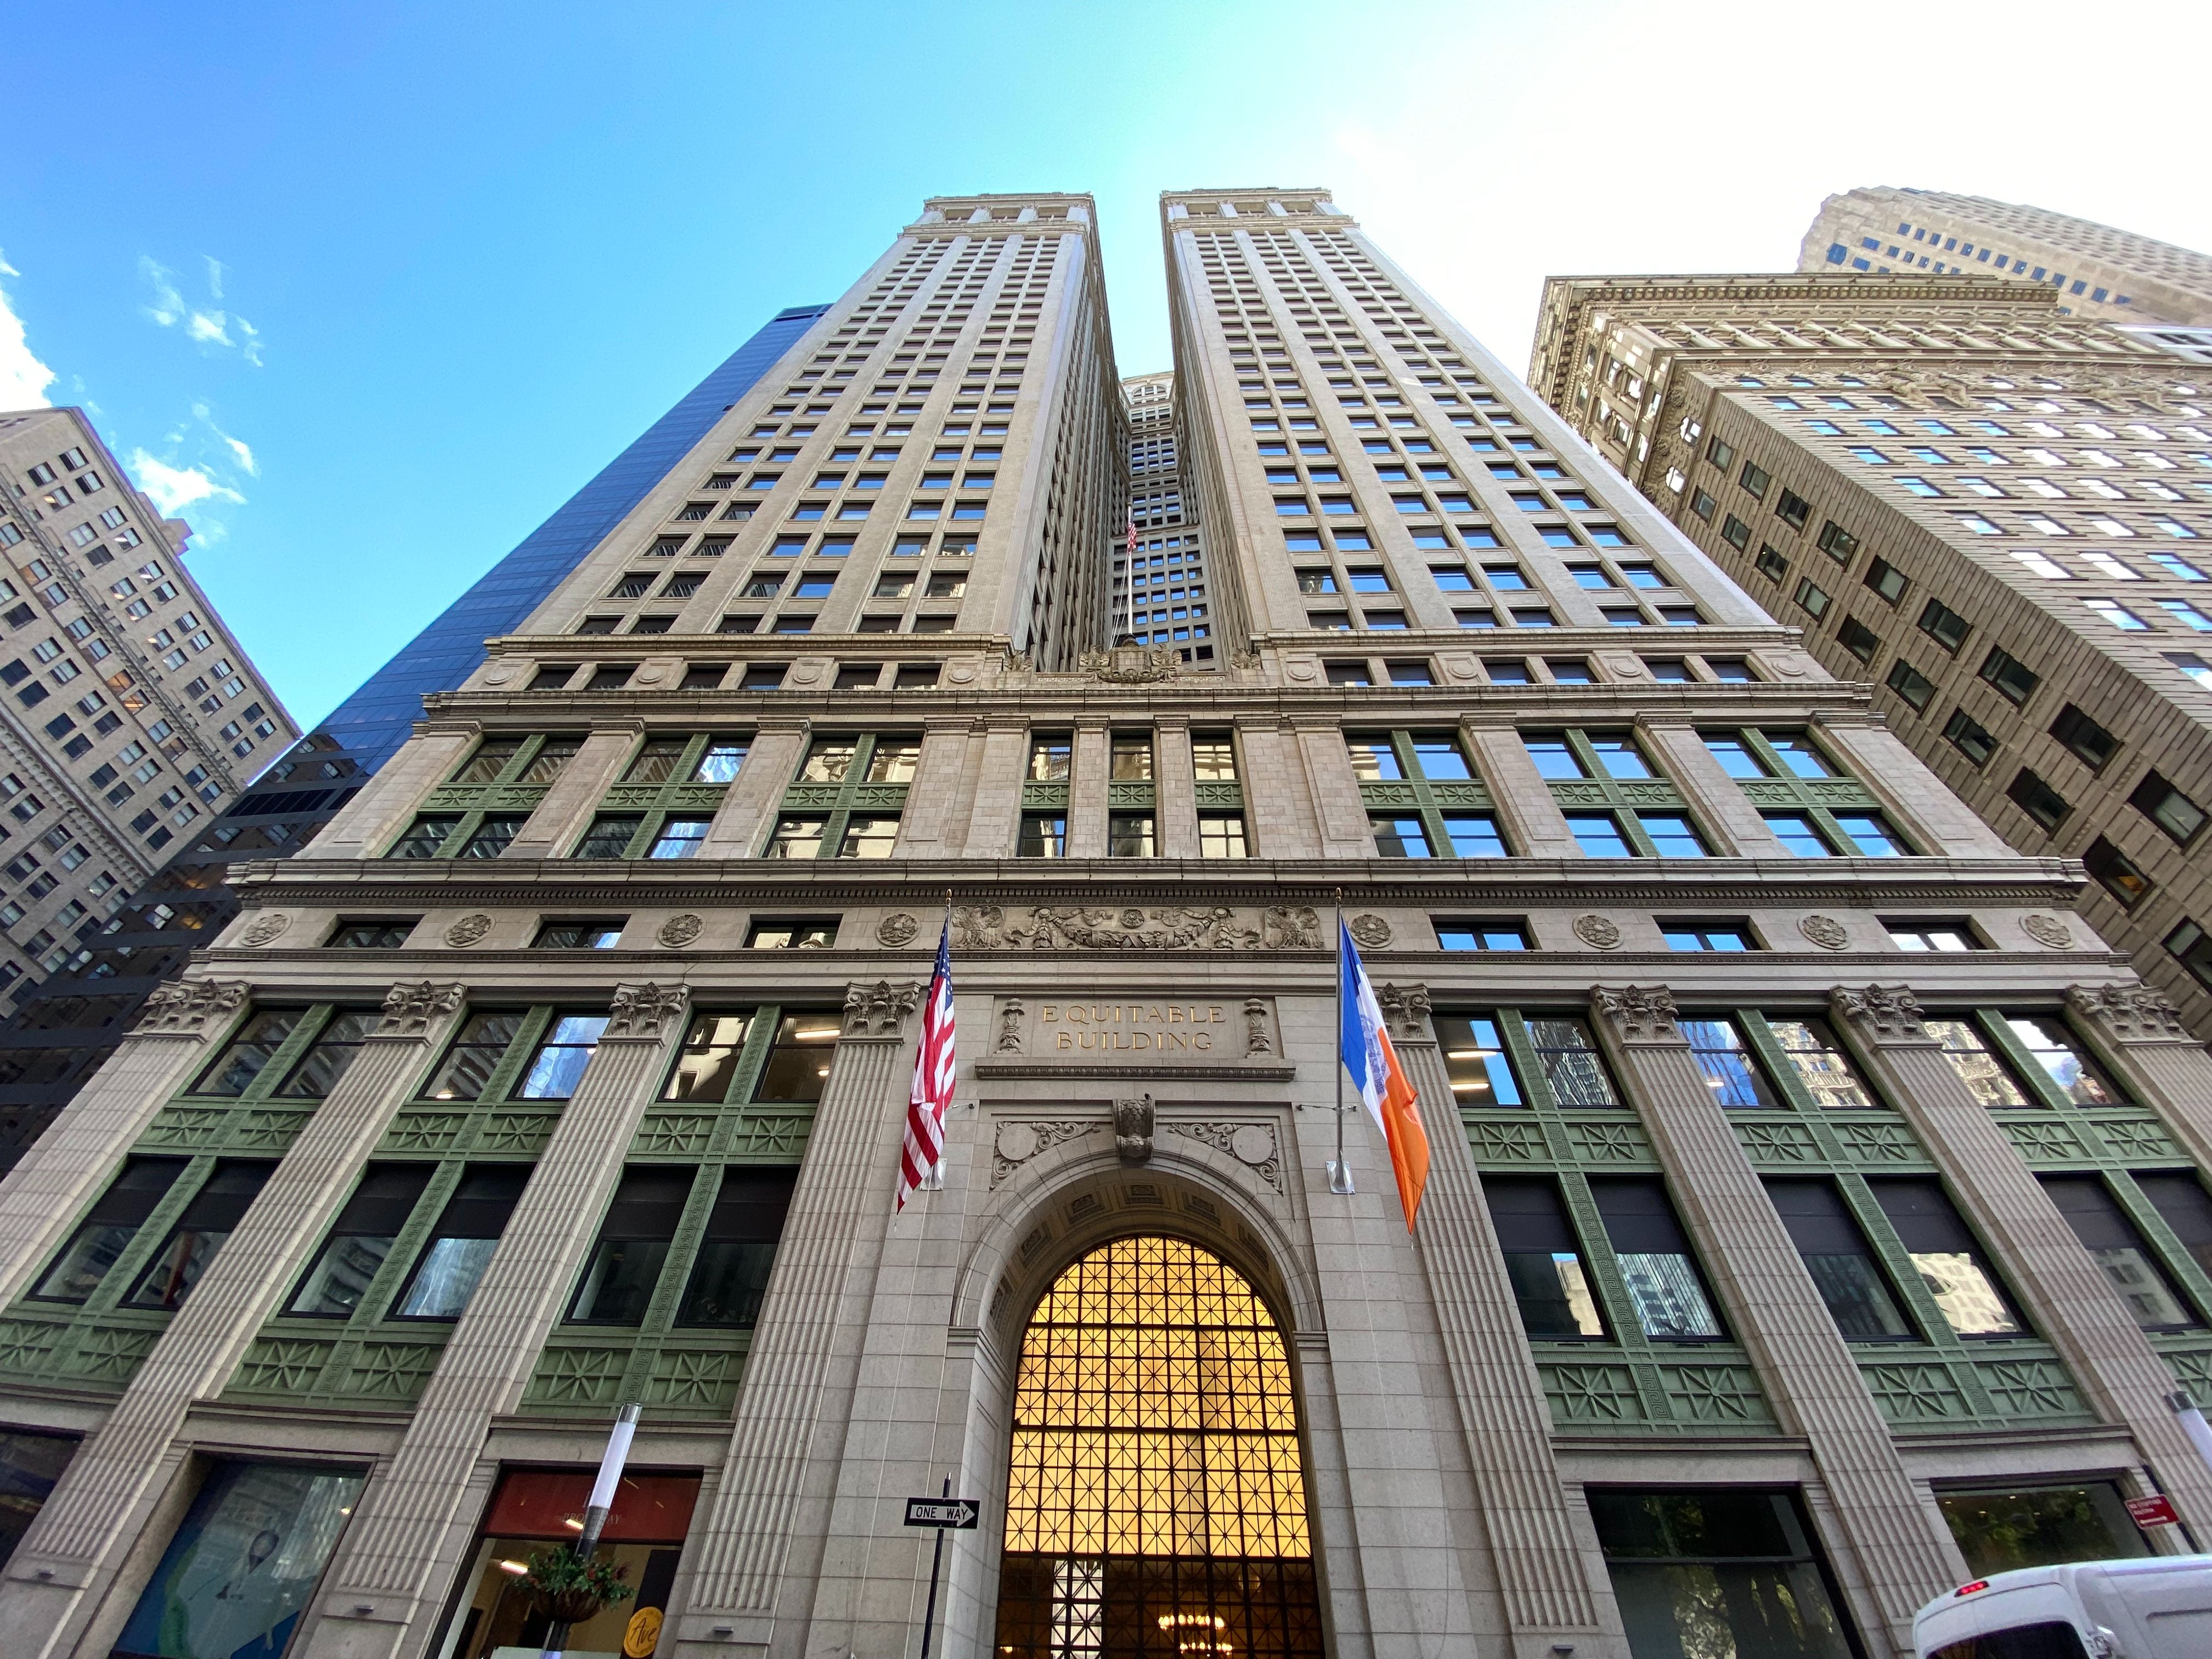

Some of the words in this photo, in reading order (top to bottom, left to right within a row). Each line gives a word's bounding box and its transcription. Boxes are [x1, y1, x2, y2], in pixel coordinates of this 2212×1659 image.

[1042, 1005, 1227, 1025] EQUITABLE
[1056, 1031, 1212, 1051] BUILDING
[916, 1506, 938, 1519] ONE
[946, 1508, 968, 1520] WAY
